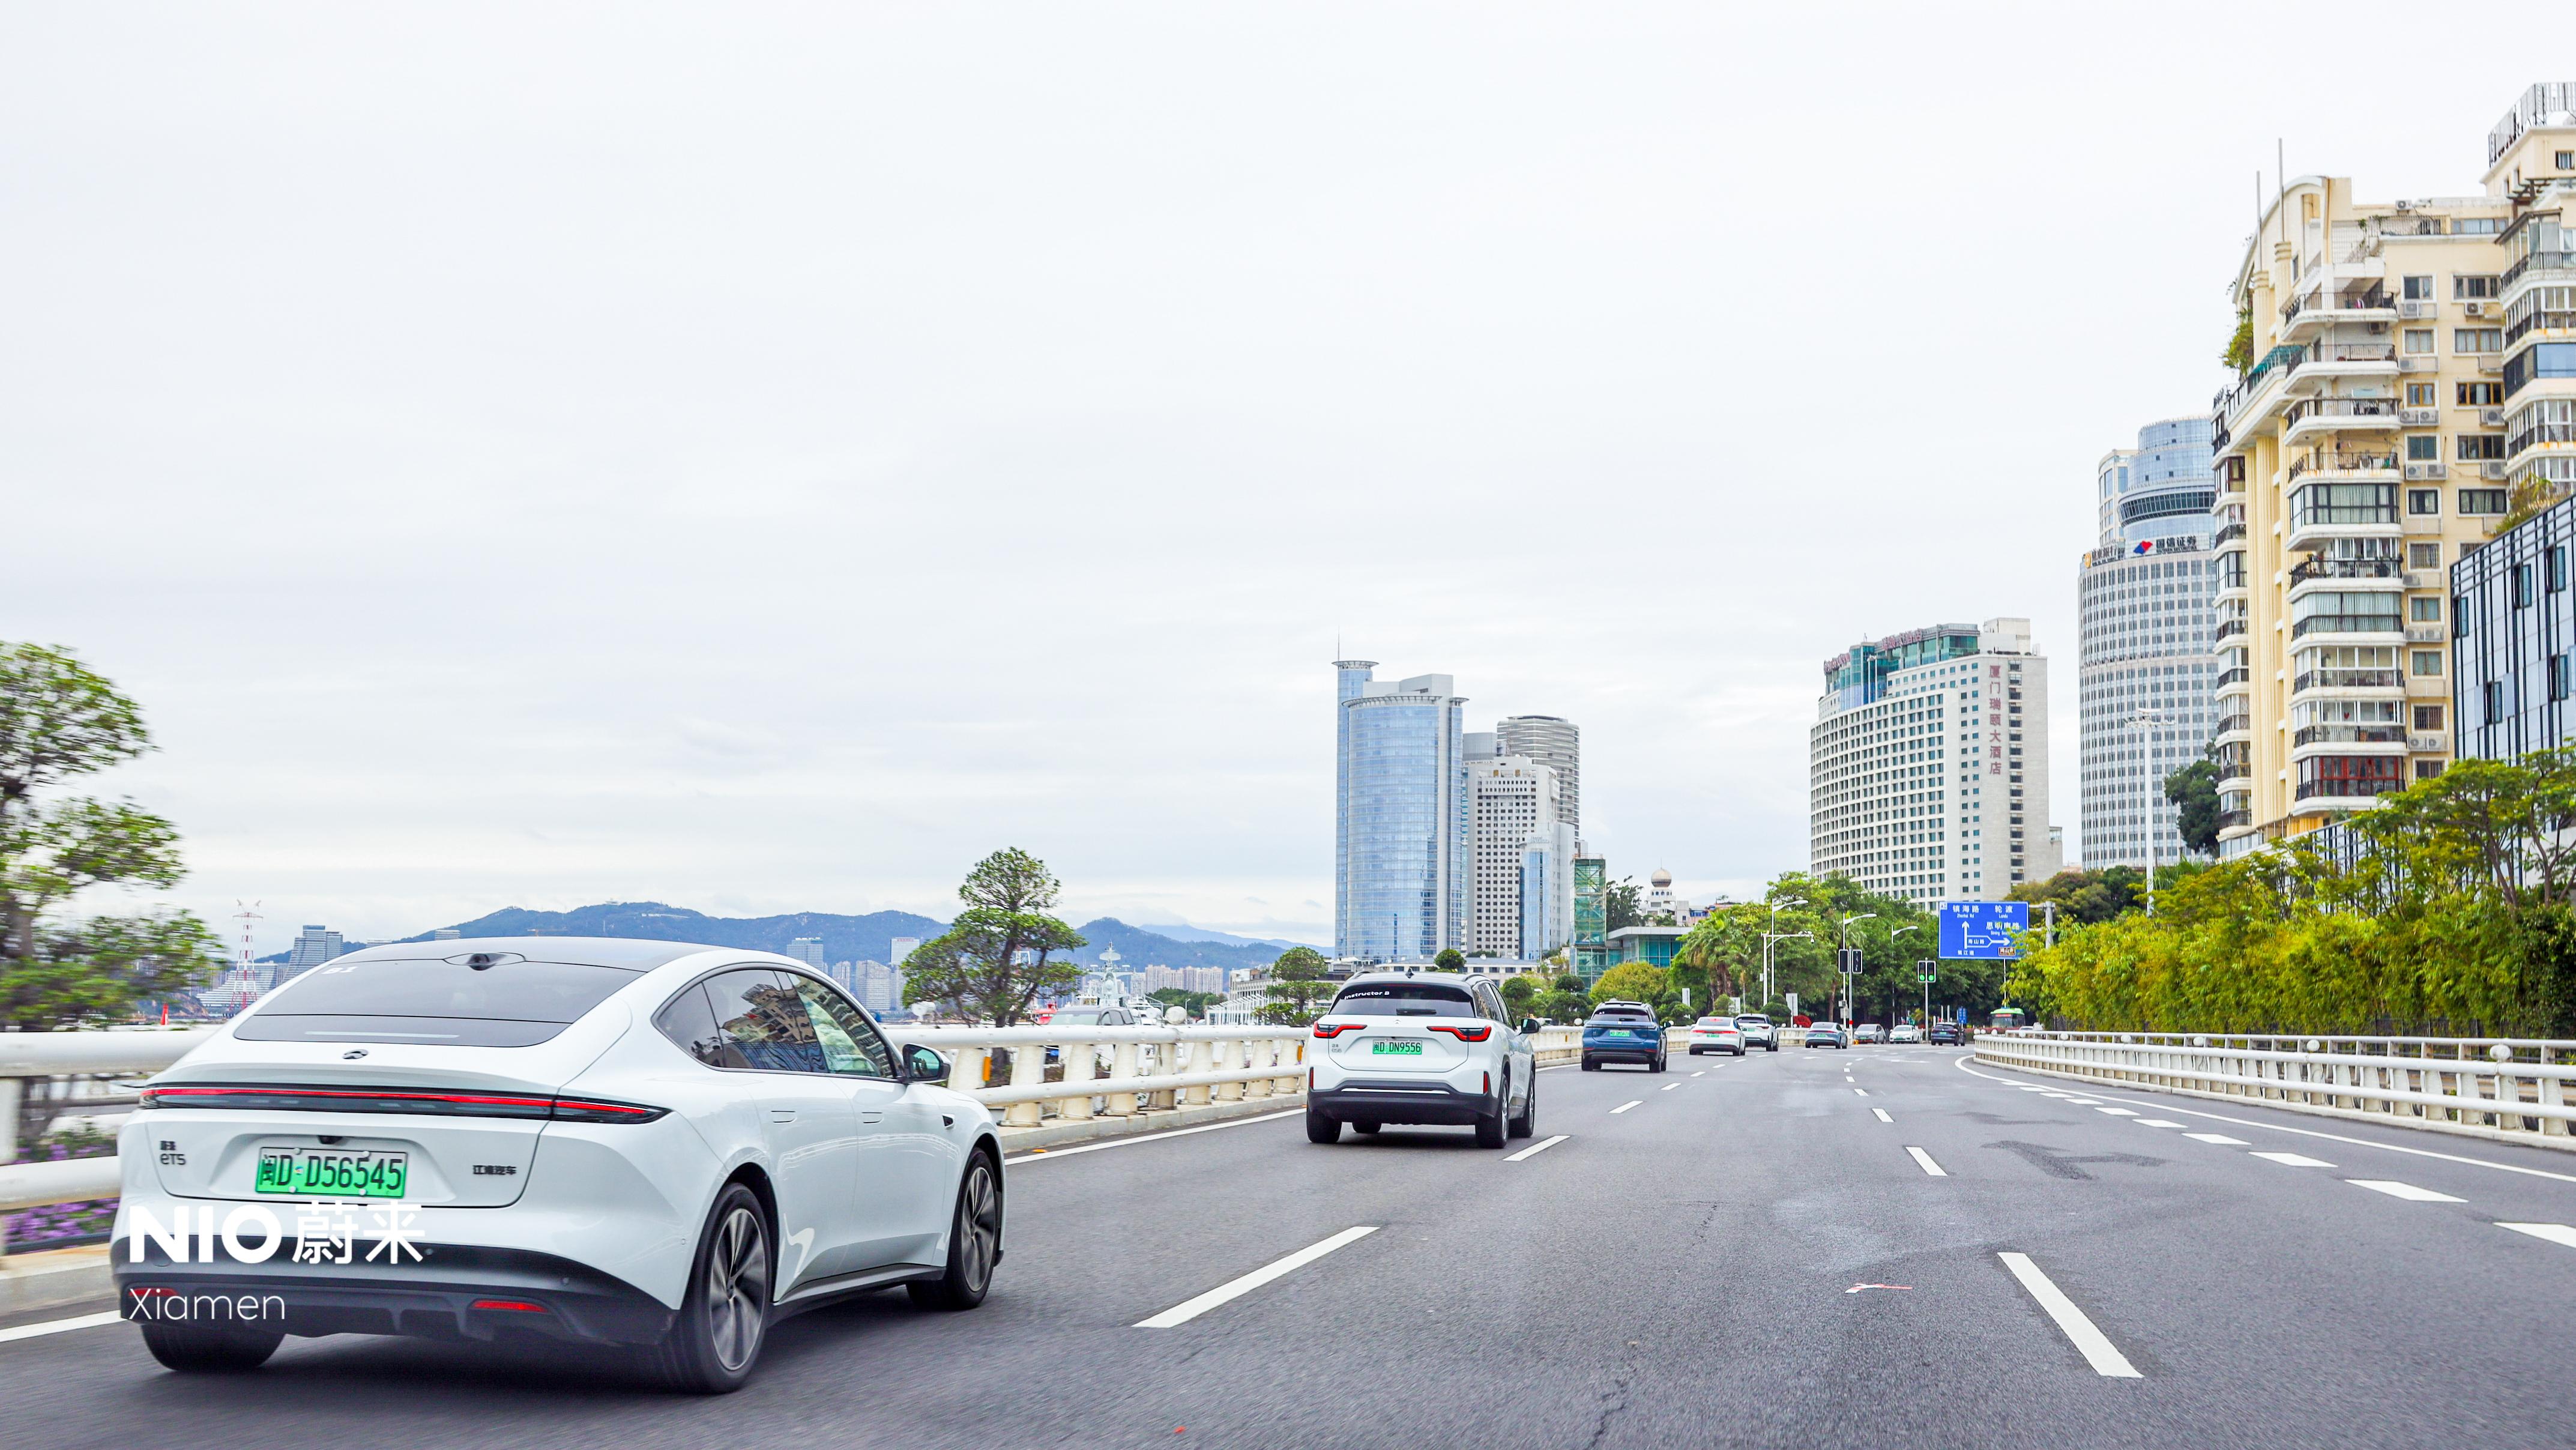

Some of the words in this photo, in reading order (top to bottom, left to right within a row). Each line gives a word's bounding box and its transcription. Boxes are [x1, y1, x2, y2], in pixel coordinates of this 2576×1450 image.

[2156, 535, 2197, 548] 国信证券
[1989, 665, 2002, 775] 厦门瑞颐大酒店
[1953, 905, 1979, 913] 镇海路
[1994, 905, 2013, 913] 轮渡
[1344, 991, 1383, 1000] Instructor
